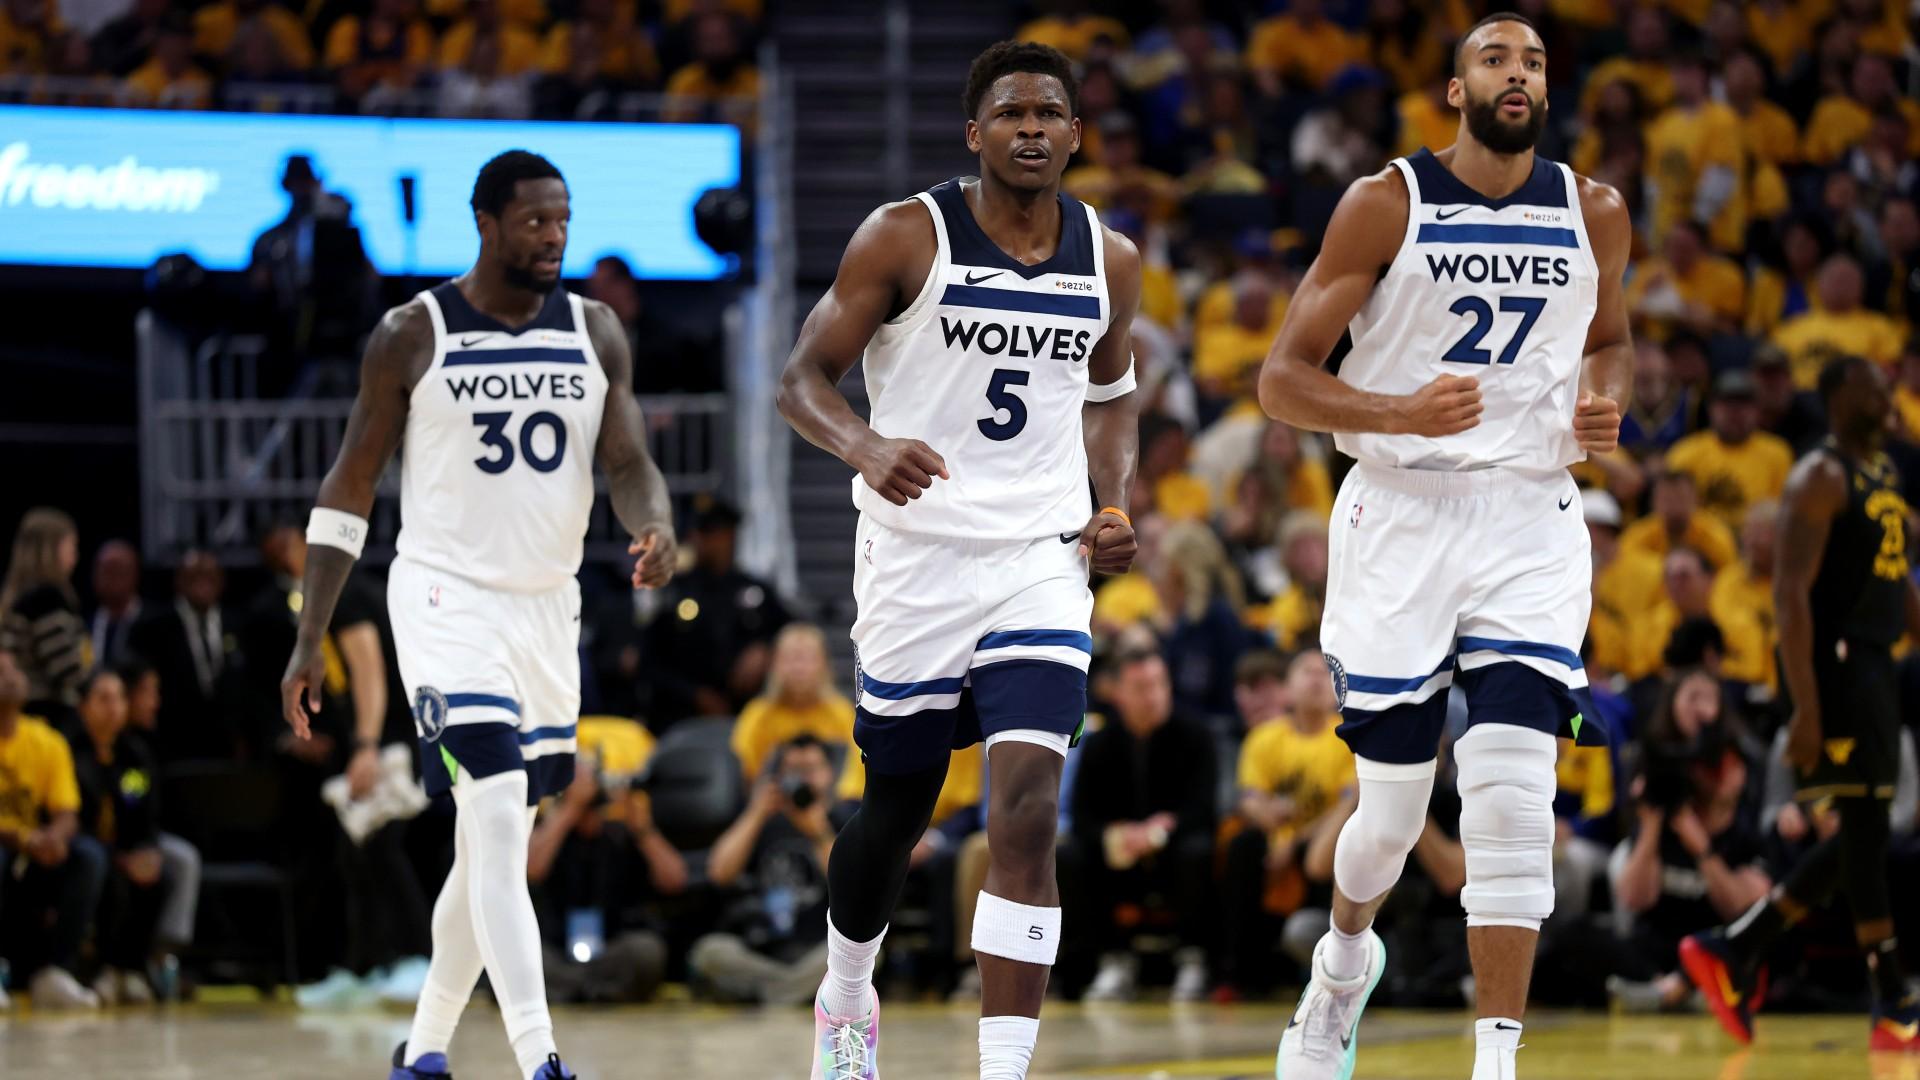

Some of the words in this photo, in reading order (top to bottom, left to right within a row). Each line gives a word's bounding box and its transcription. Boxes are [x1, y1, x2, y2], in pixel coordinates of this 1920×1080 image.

[1531, 213, 1561, 222] sezzle
[1426, 254, 1569, 286] WOLVES
[1061, 281, 1093, 291] sezzle
[940, 316, 1091, 362] WOLVES
[1441, 295, 1548, 365] 27
[446, 374, 585, 401] WOLVES
[977, 368, 1030, 441] 5
[472, 411, 566, 474] 30
[338, 523, 358, 543] 30
[1028, 925, 1043, 940] 5
